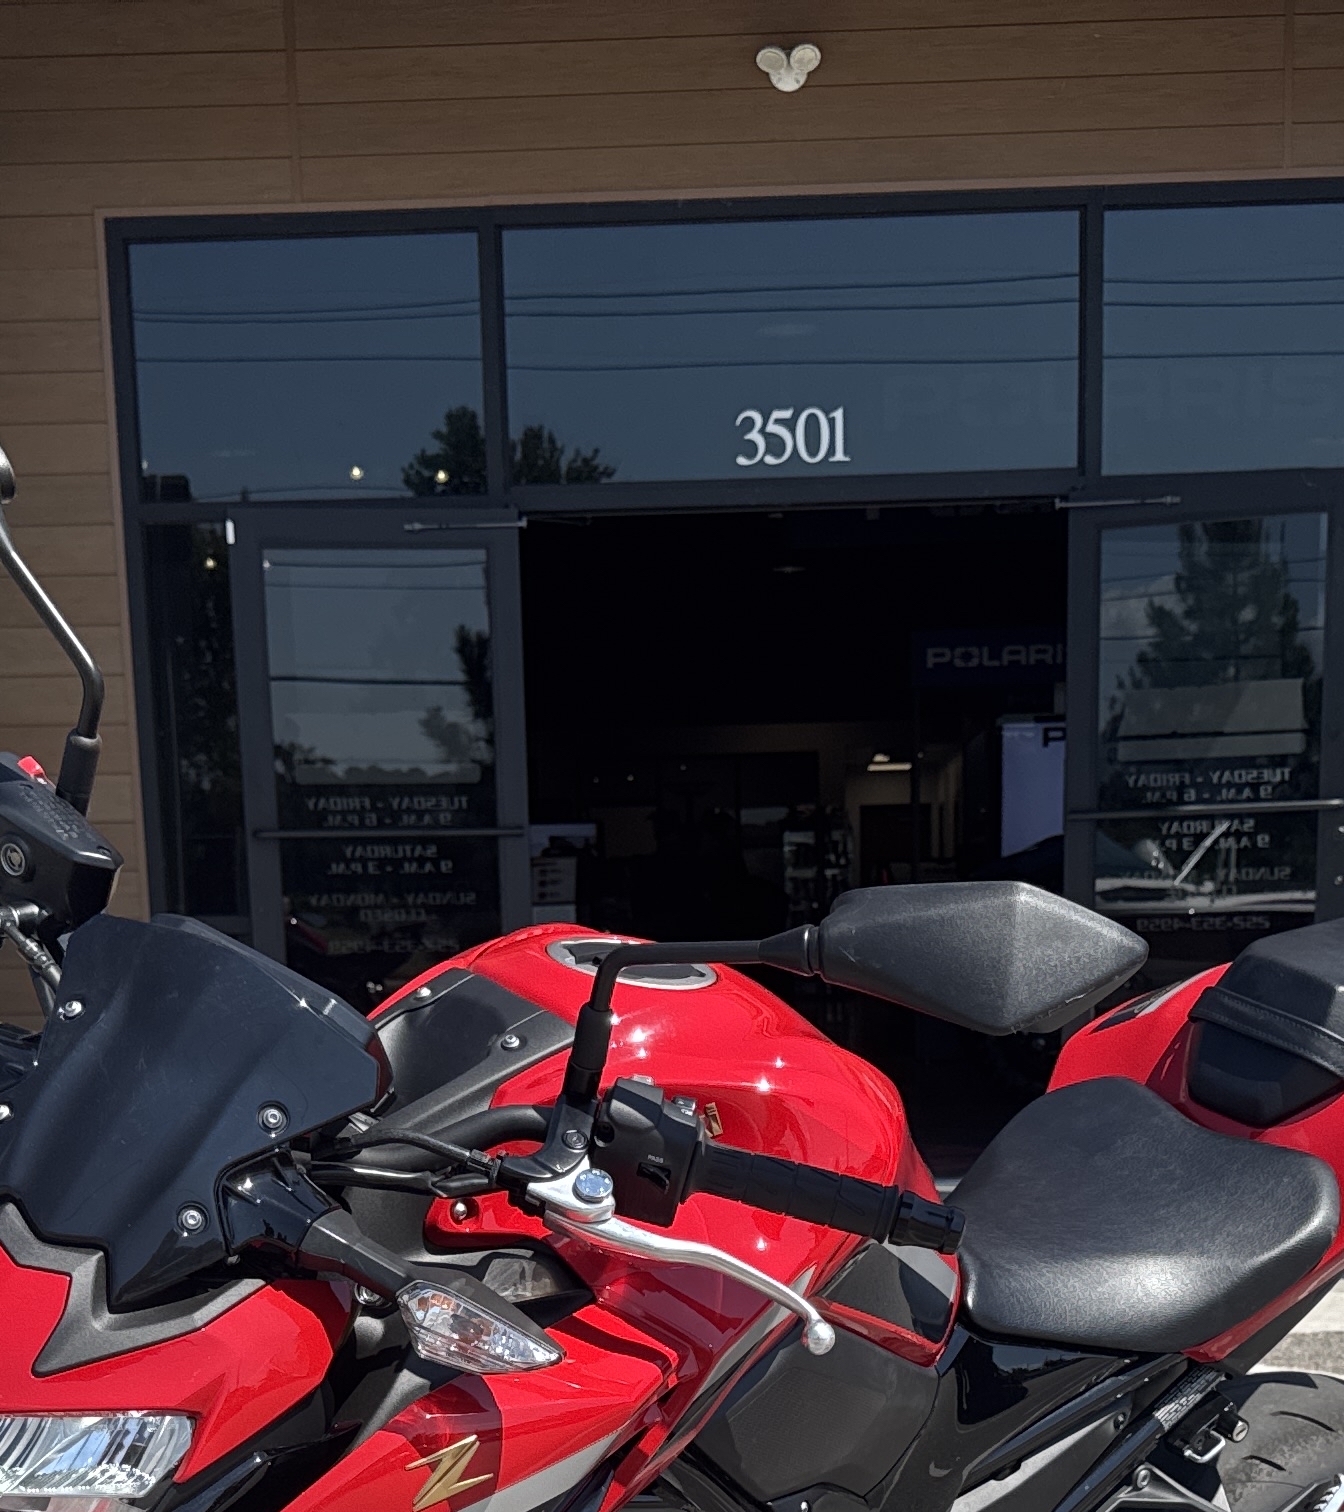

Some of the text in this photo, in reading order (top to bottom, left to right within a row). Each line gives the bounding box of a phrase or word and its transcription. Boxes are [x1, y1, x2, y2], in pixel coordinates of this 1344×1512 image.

[735, 406, 851, 467] 3501
[925, 643, 1064, 670] POLARI
[404, 1434, 495, 1512] Z
